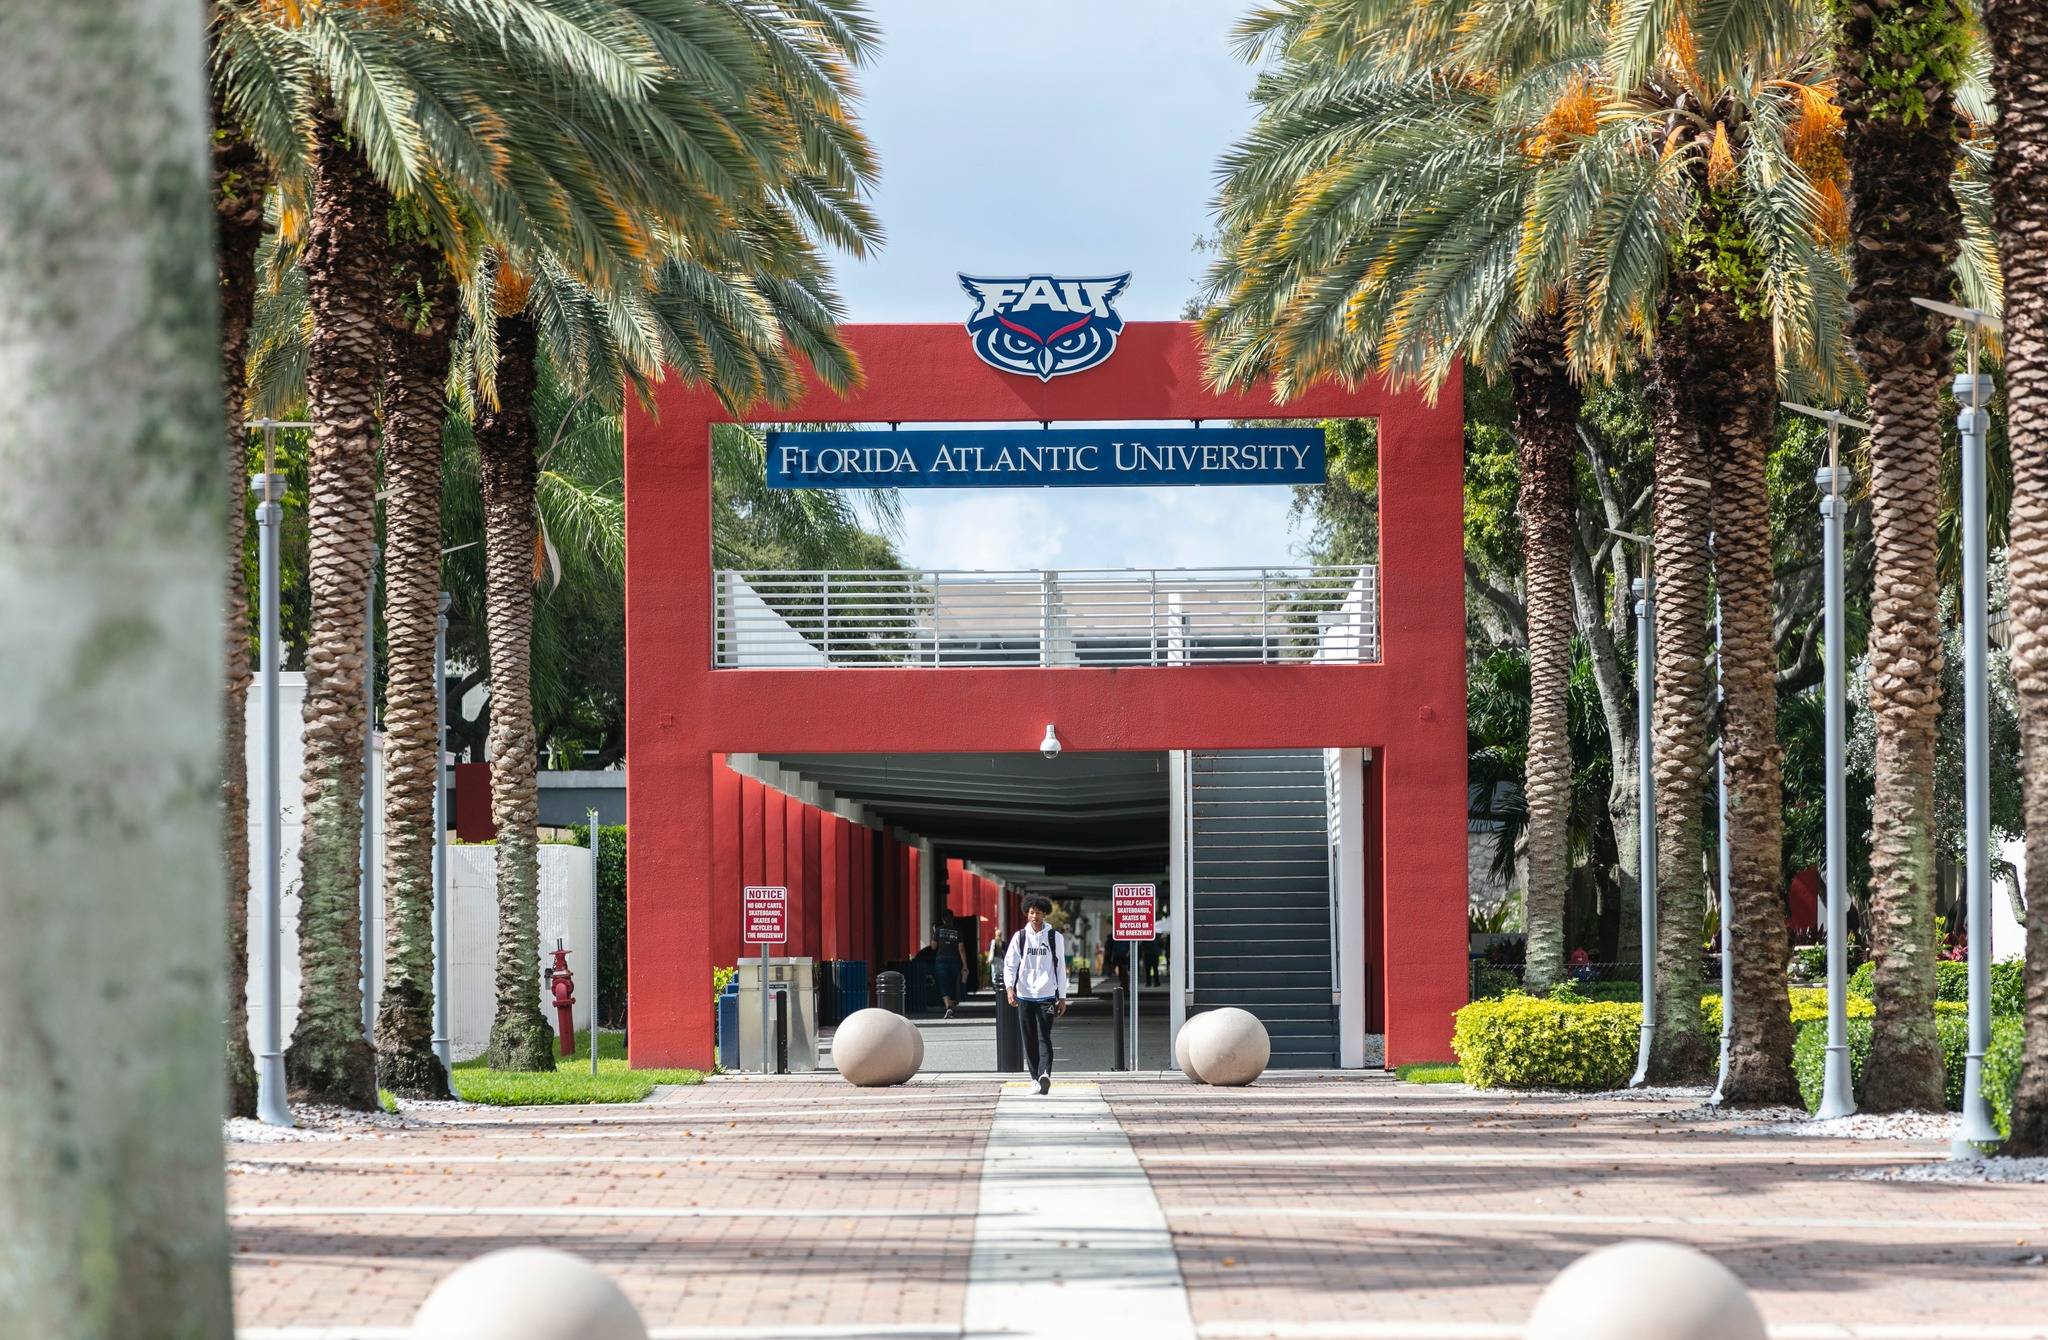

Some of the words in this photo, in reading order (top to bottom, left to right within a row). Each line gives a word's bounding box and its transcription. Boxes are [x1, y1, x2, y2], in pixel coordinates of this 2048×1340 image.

[968, 279, 1120, 322] FAU
[779, 446, 918, 474] FLORIDA
[929, 444, 1098, 473] ATLANTIC
[1112, 443, 1311, 471] UNIVERSITY
[749, 890, 783, 899] NOTICE
[1117, 887, 1151, 896] NOTICE
[1027, 947, 1047, 955] PUMA
